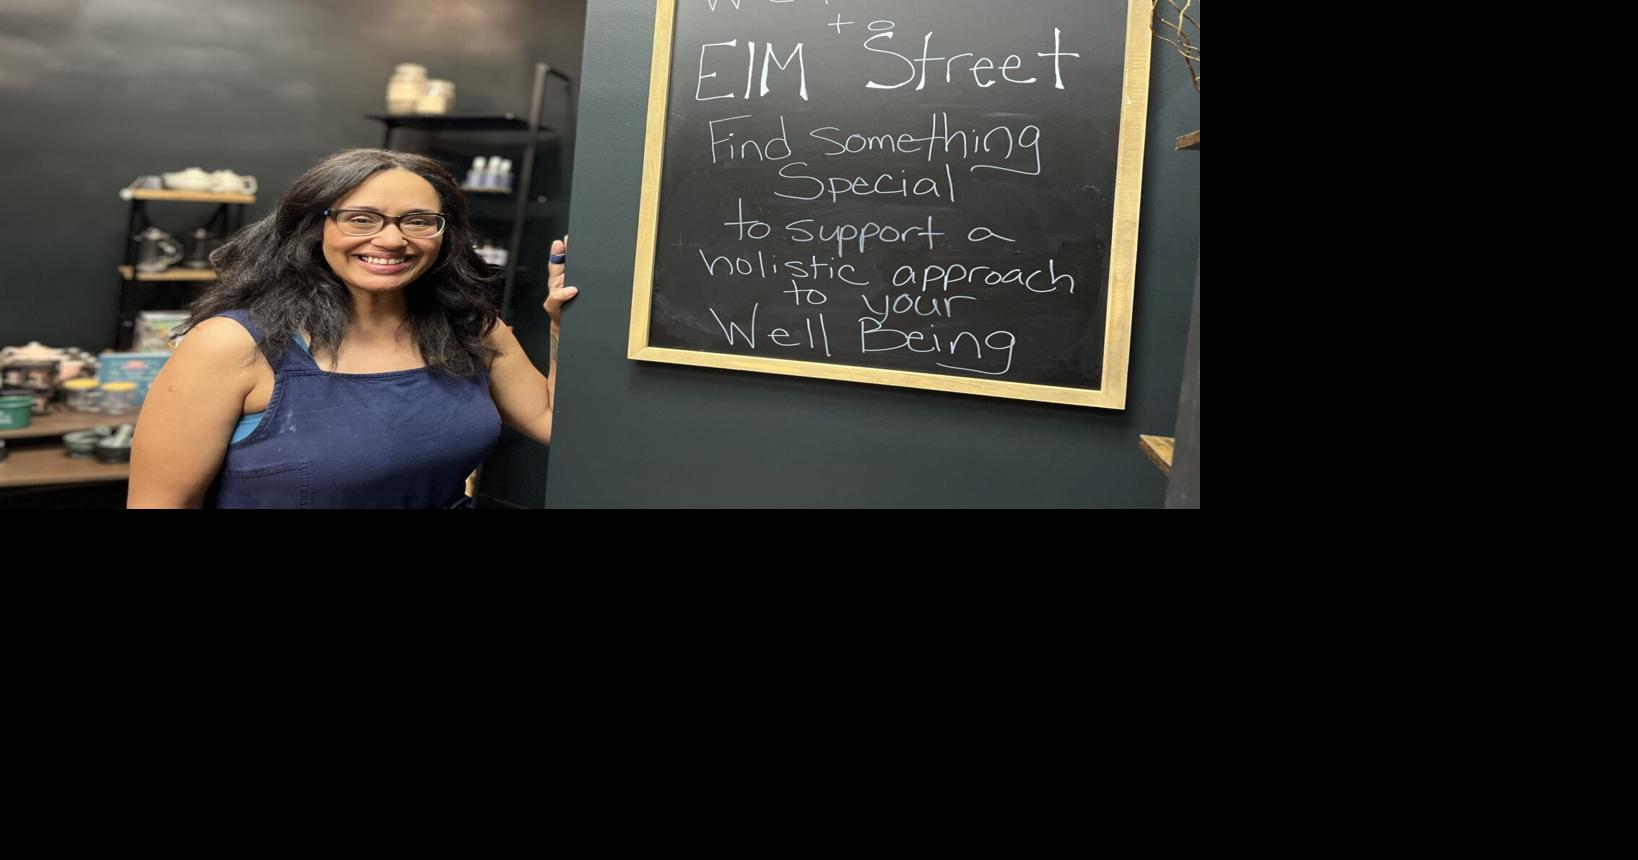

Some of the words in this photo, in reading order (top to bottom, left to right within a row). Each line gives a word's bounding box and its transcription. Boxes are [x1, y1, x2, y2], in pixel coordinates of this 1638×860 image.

[864, 28, 1080, 90] Street
[709, 115, 792, 164] Find
[724, 198, 771, 240] to
[785, 216, 944, 257] support
[967, 226, 1015, 242] a
[699, 249, 869, 285] holistic
[892, 259, 1075, 294] approach
[784, 280, 827, 305] to
[862, 293, 977, 323] your
[709, 303, 832, 357] Well
[858, 317, 1015, 374] Being
